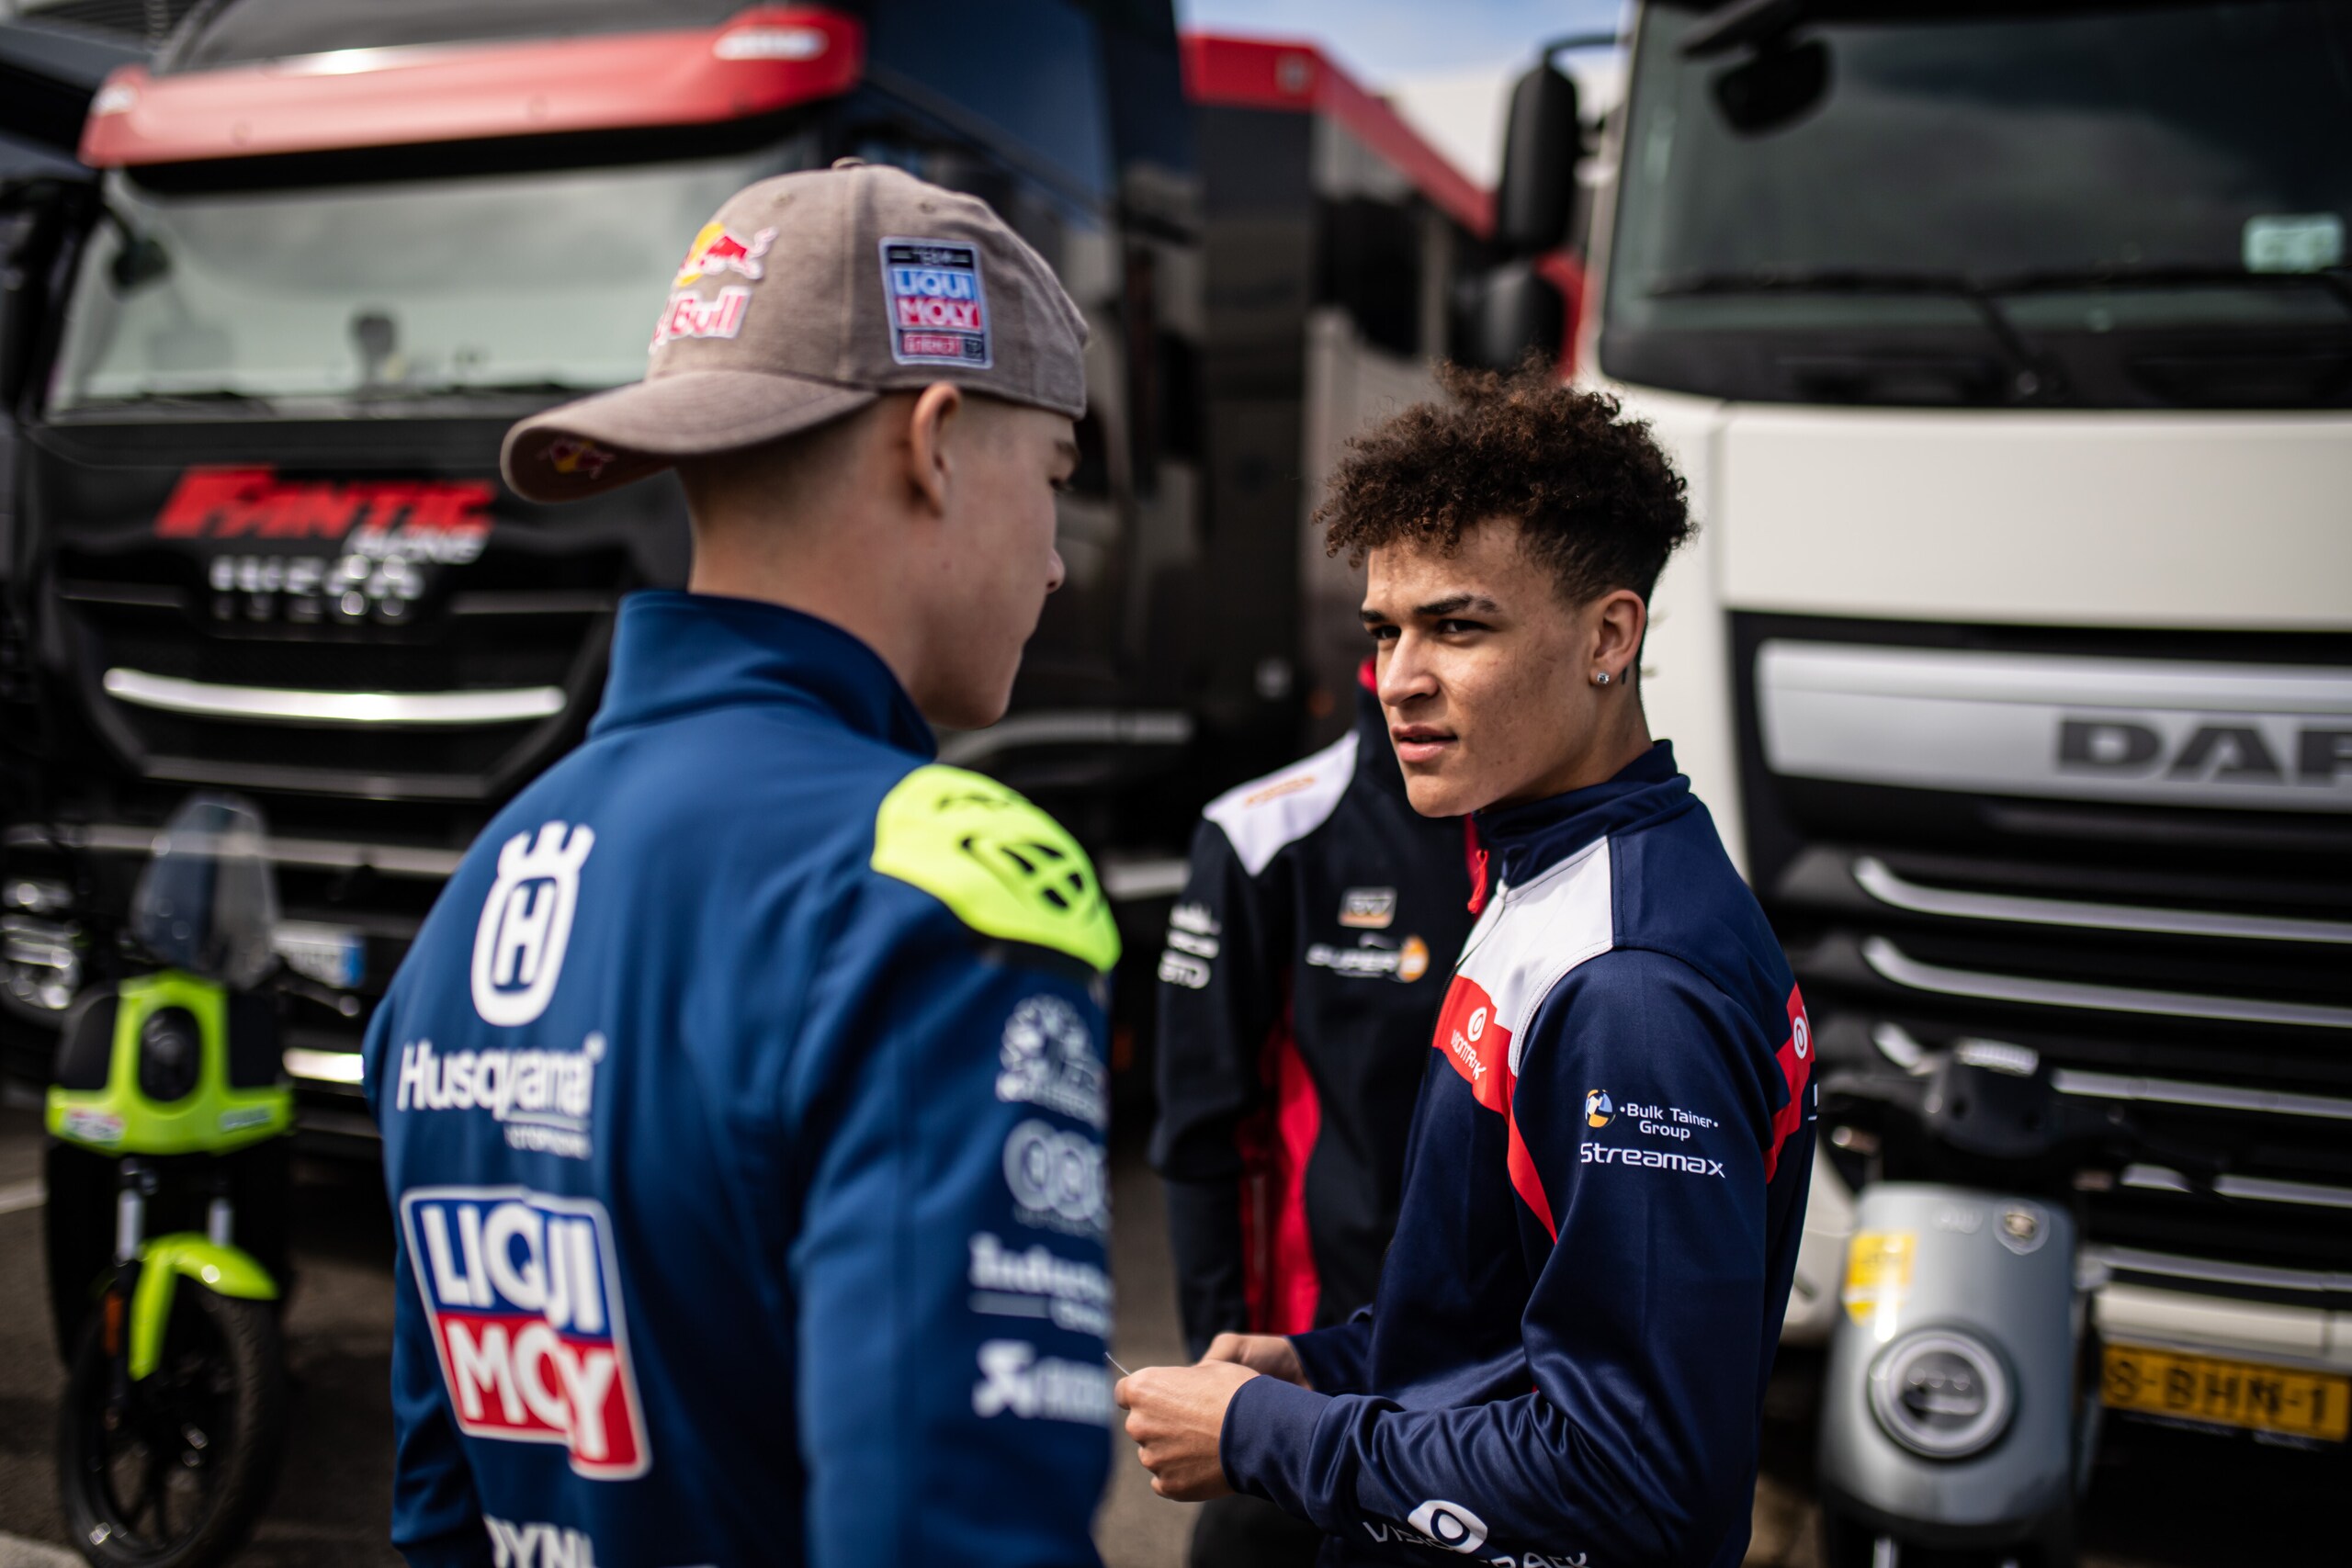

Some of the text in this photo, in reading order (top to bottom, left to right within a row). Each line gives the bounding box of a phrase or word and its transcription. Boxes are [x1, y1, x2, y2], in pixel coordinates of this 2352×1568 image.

[893, 269, 974, 299] LIQUI
[670, 291, 748, 337] Bull
[898, 298, 980, 329] MOLY
[2056, 719, 2352, 788] DAF
[1627, 1103, 1713, 1128] Bulk Tainer
[1639, 1120, 1690, 1141] Group
[1580, 1143, 1725, 1179] Streamax
[444, 1318, 616, 1461] MOY
